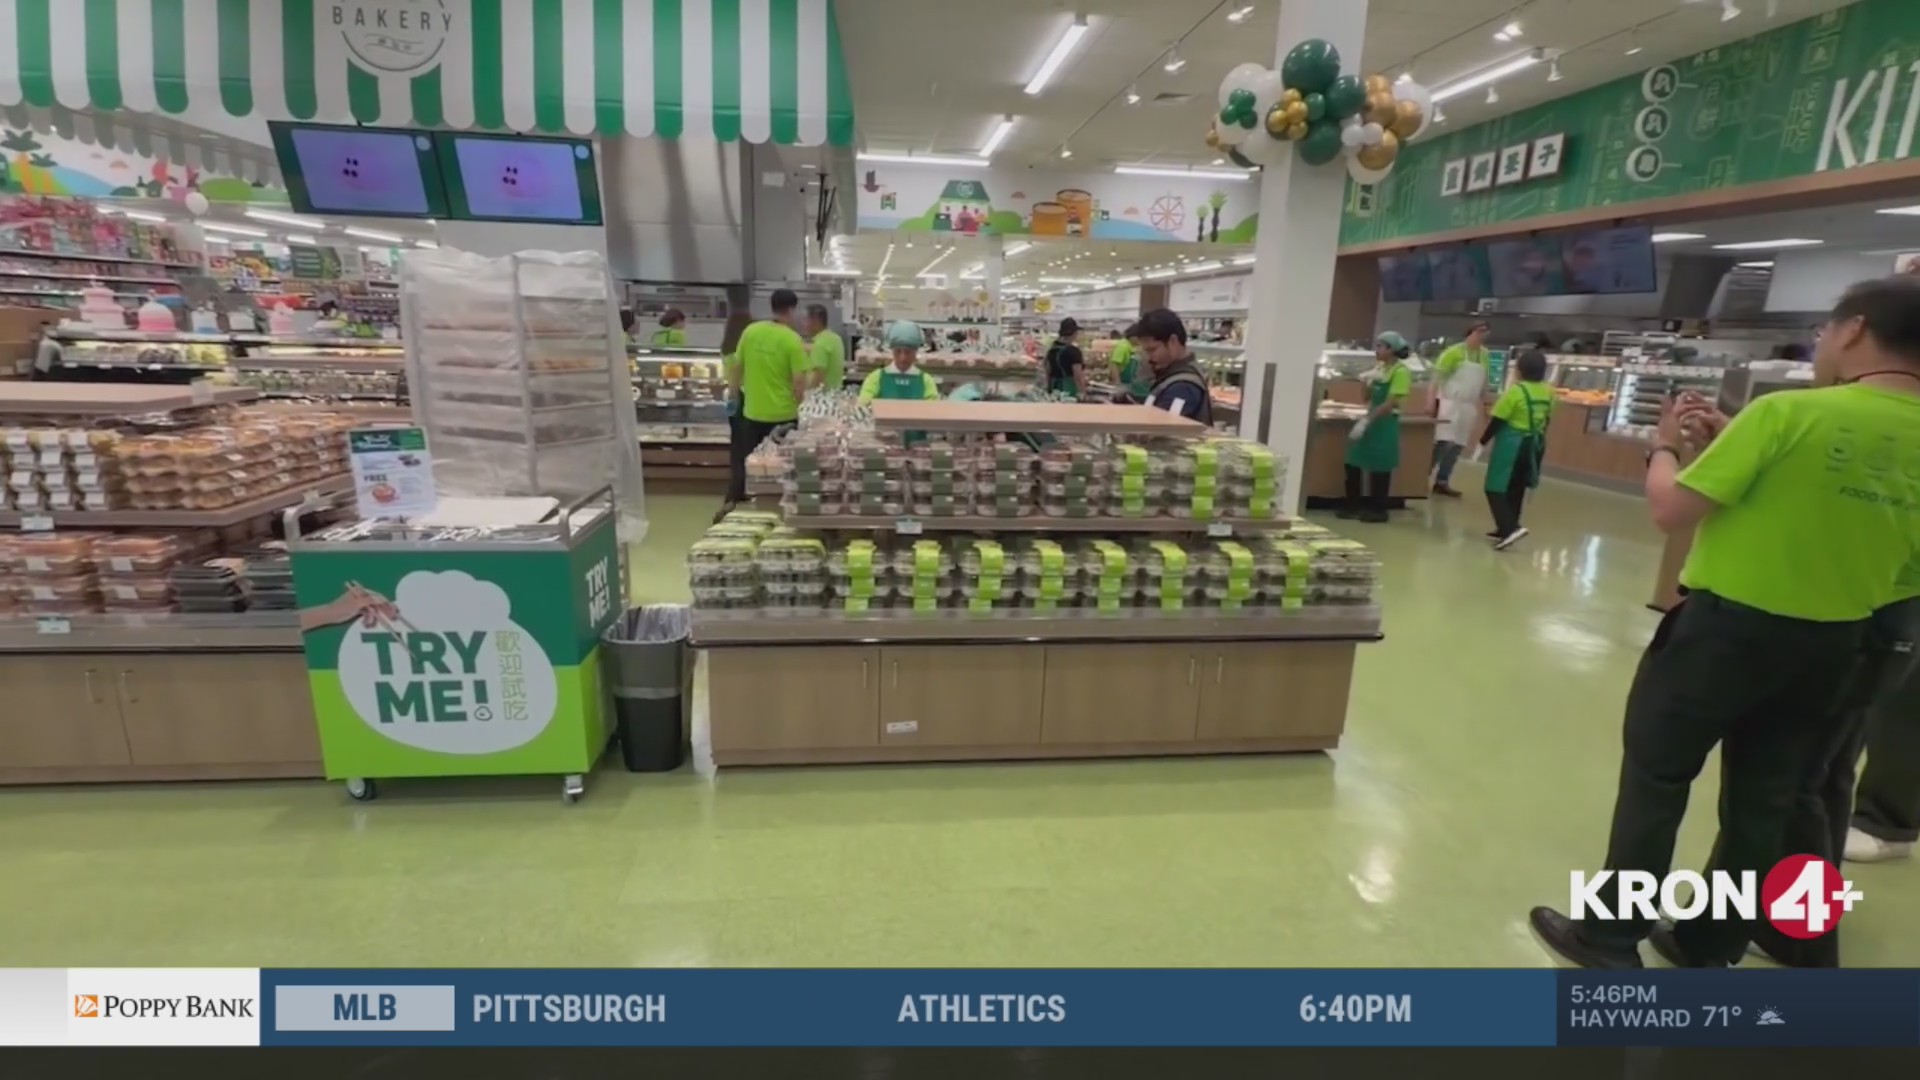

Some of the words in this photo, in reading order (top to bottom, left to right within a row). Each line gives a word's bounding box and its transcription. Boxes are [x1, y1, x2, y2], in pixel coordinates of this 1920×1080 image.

[332, 6, 451, 32] BAKERY
[585, 556, 608, 598] TRY
[589, 585, 610, 628] ME!
[360, 631, 487, 675] TRY
[495, 630, 529, 721] 歡迎試吃
[375, 679, 493, 724] ME!
